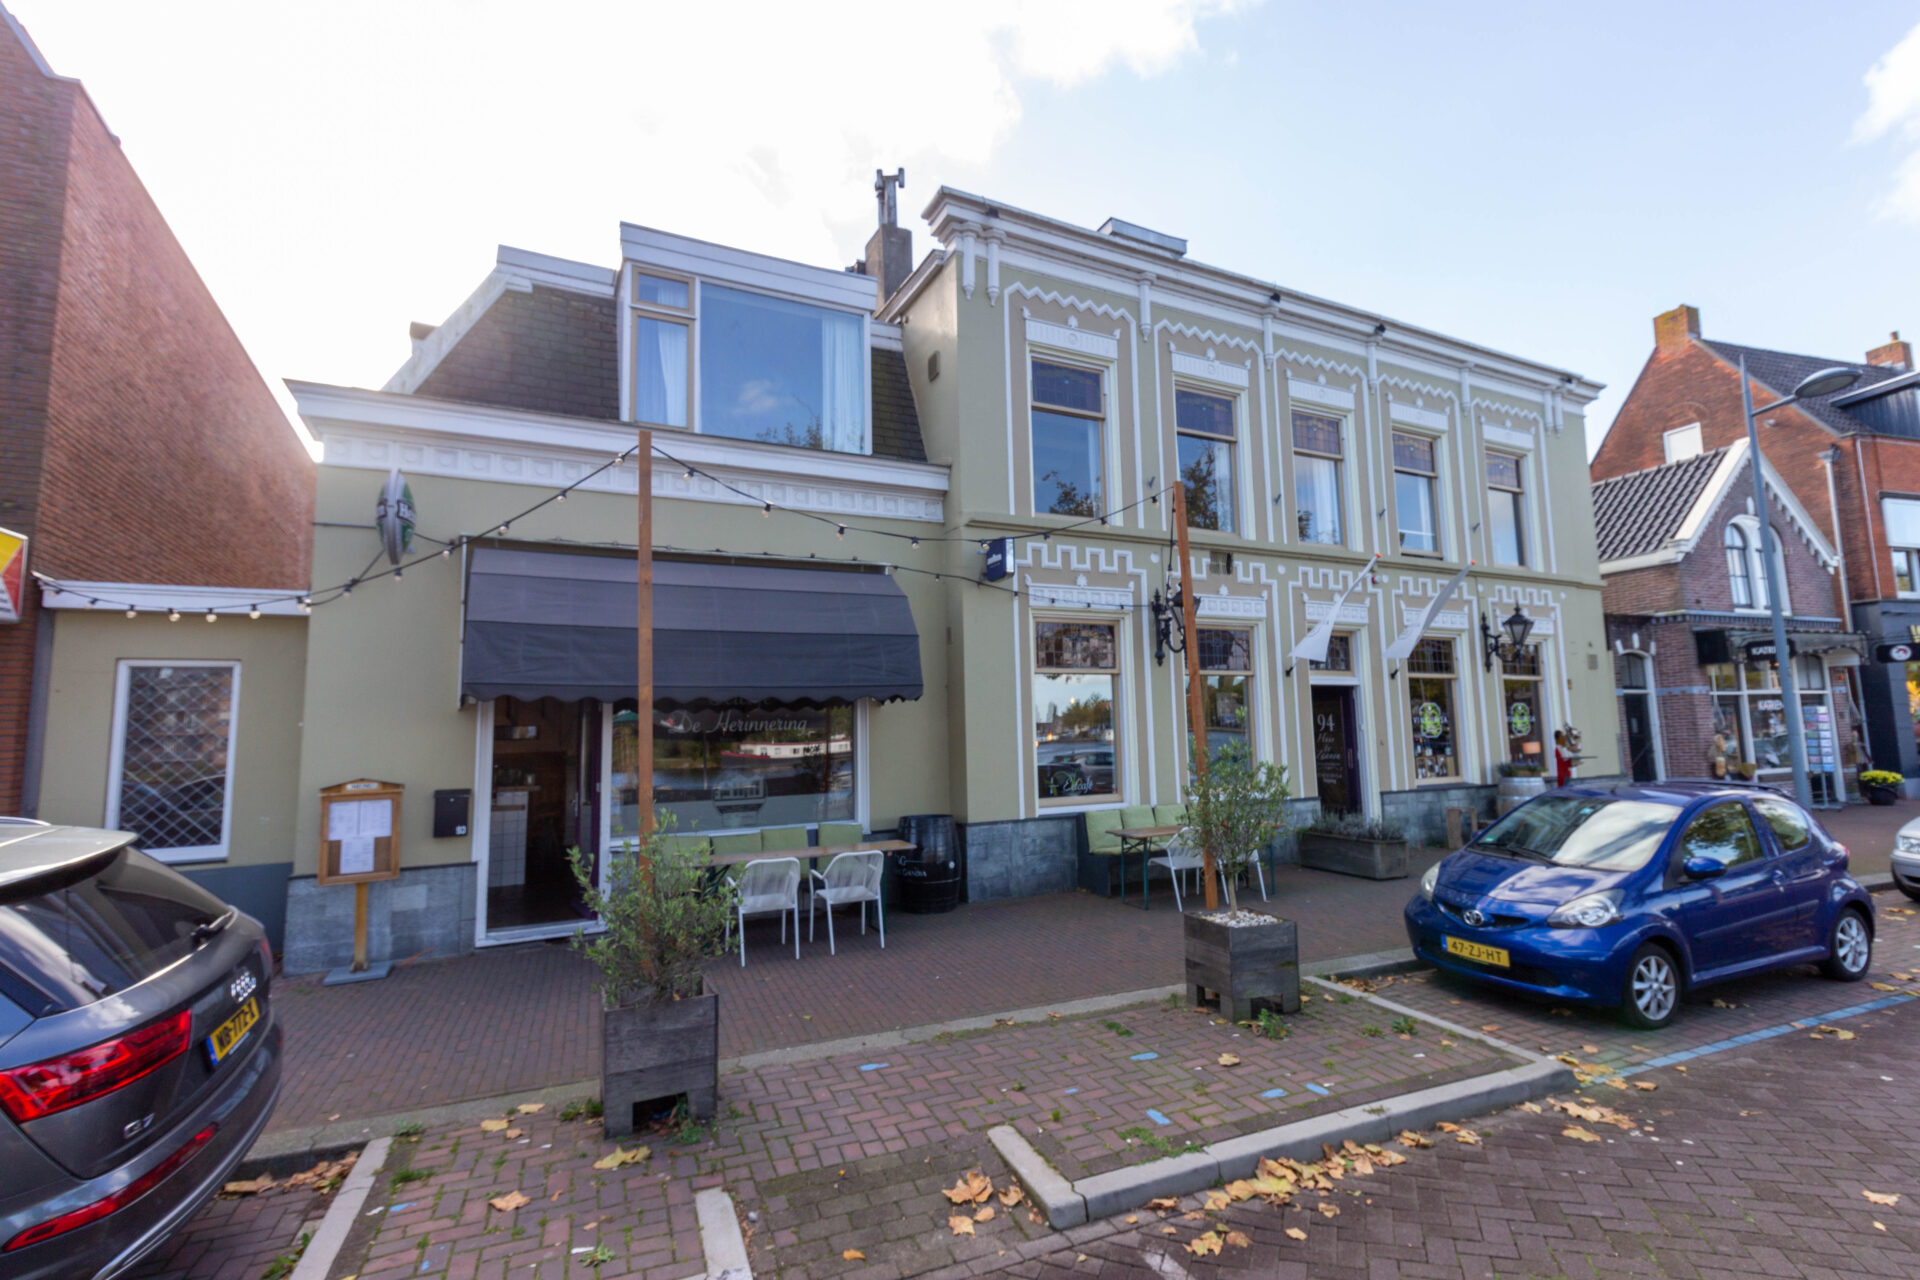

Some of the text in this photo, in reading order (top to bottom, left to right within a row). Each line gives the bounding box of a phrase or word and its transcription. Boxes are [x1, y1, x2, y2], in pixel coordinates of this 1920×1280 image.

[668, 709, 808, 734] De Herinnering
[1317, 713, 1335, 732] 94
